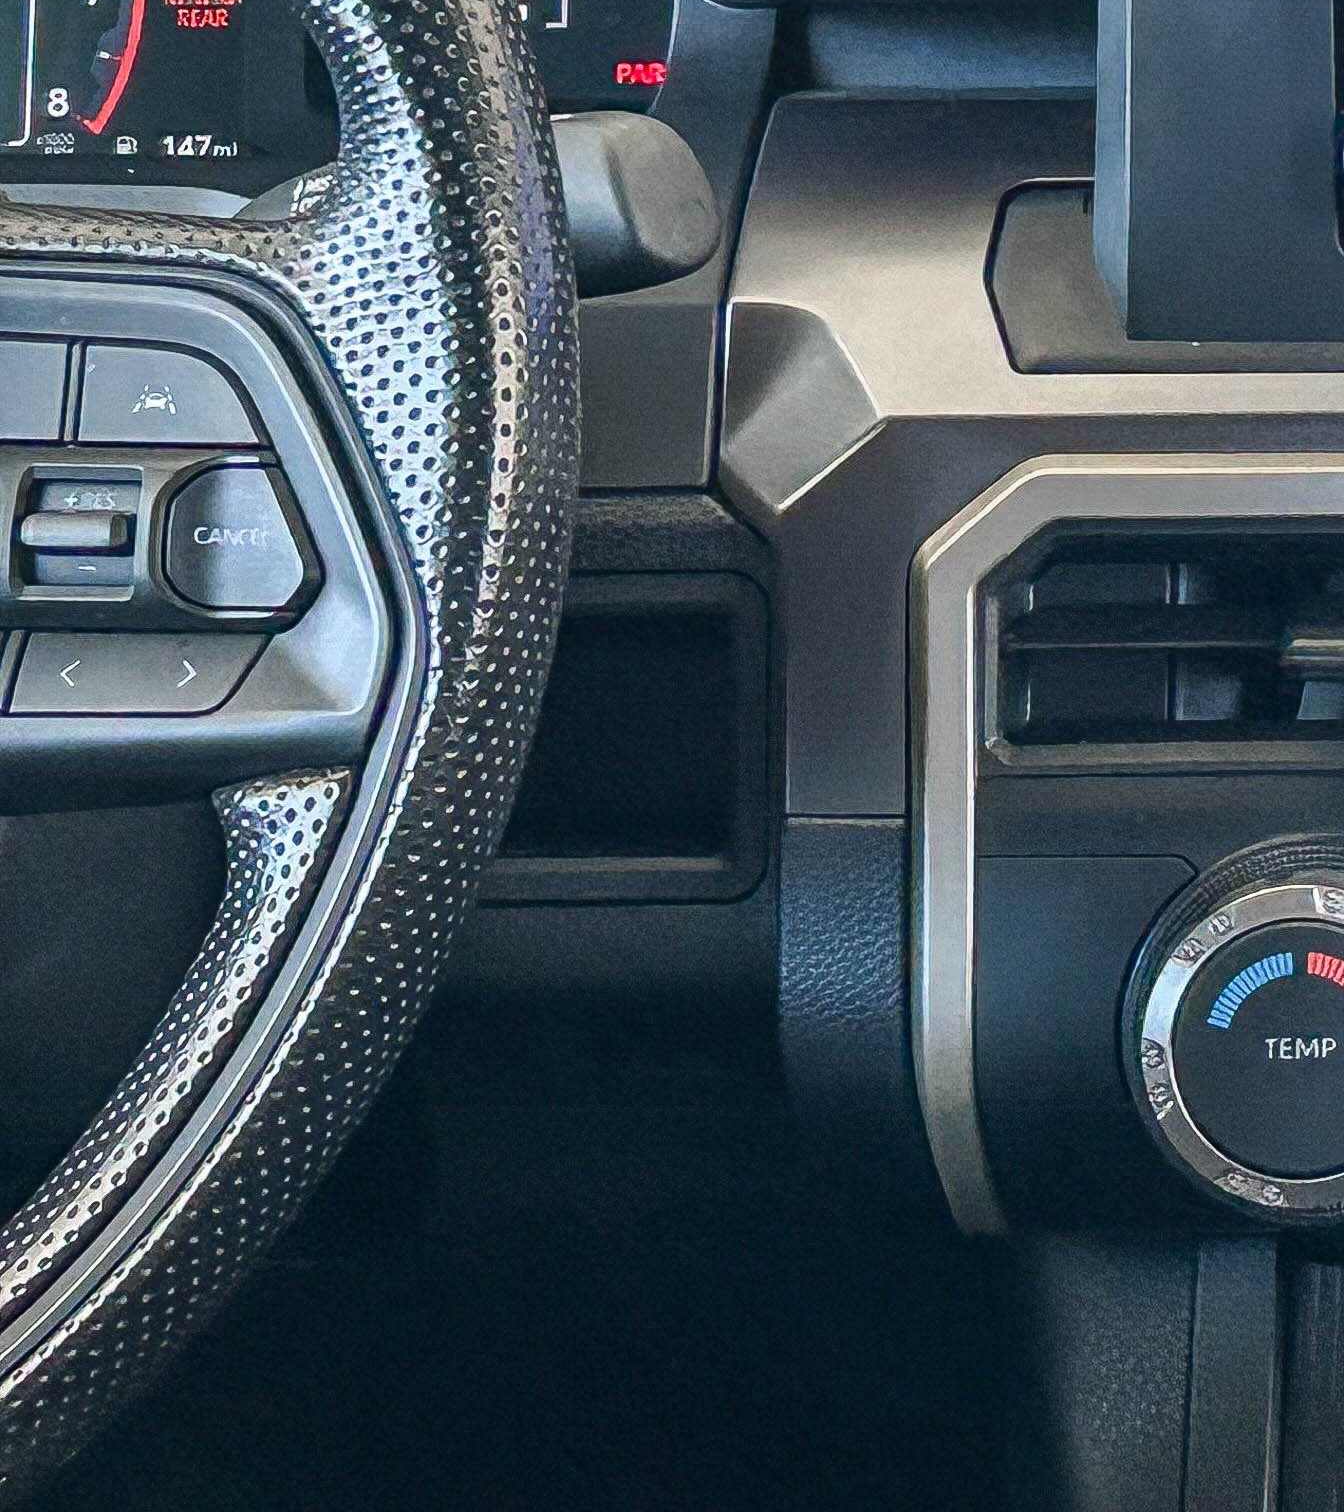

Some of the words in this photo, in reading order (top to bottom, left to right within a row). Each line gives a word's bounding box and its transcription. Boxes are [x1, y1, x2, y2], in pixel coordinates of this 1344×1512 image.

[177, 8, 229, 28] REAR
[615, 62, 667, 85] PAR
[47, 88, 70, 118] 8
[1265, 1037, 1337, 1059] TEMP
